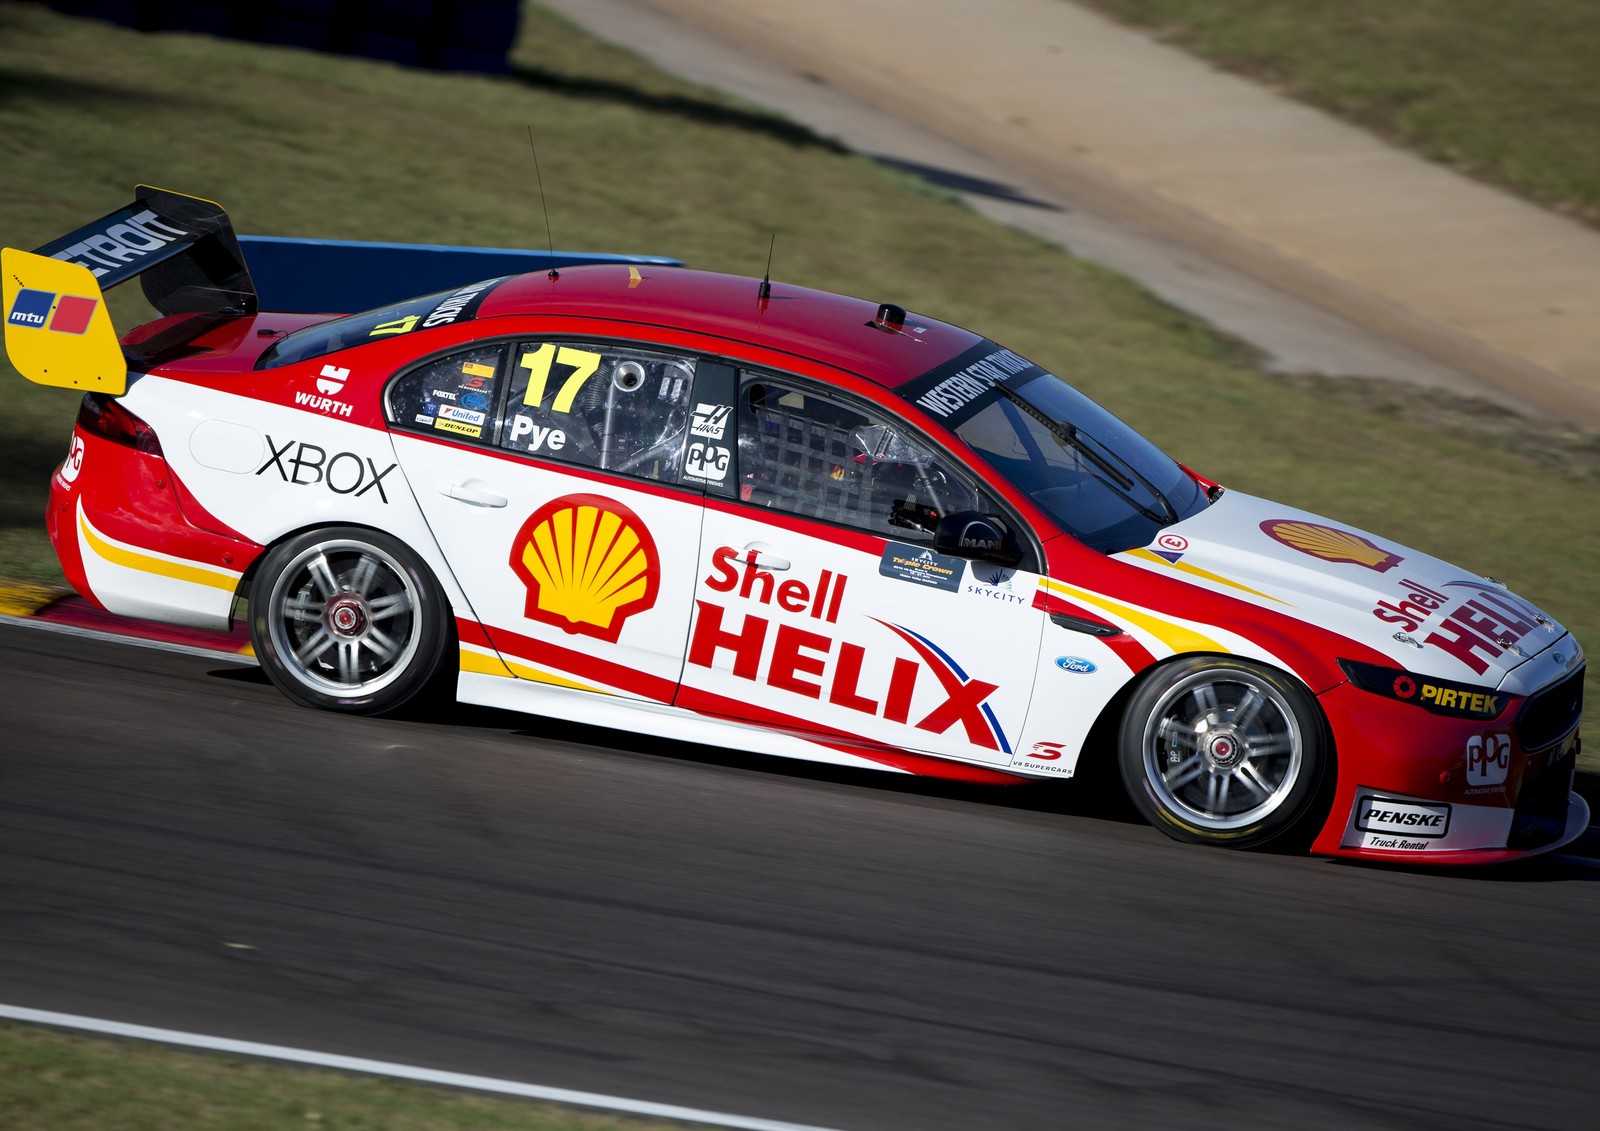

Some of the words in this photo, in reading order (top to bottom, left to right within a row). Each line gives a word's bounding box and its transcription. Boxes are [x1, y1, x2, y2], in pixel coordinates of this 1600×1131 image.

[11, 311, 44, 324] mtu
[520, 343, 601, 413] 17
[432, 389, 457, 401] FOXTEL
[916, 371, 988, 417] WESTERN
[966, 360, 1011, 387] STAR
[452, 409, 481, 422] United
[444, 423, 479, 434] DUNLOP
[510, 414, 566, 451] Pye
[256, 434, 398, 504] XBOX
[963, 537, 1000, 549] MAN
[922, 564, 954, 576] Crown
[704, 545, 848, 624] Shell
[967, 585, 1026, 605] SKYCITY
[1372, 578, 1450, 633] Shell
[1423, 592, 1541, 676] HELI
[1062, 657, 1090, 672] Ford
[688, 599, 1000, 752] HELIX
[1421, 684, 1498, 714] PIRTEK
[1363, 808, 1444, 827] PENSKE
[1370, 836, 1398, 849] Truck
[1398, 840, 1429, 850] Rental
